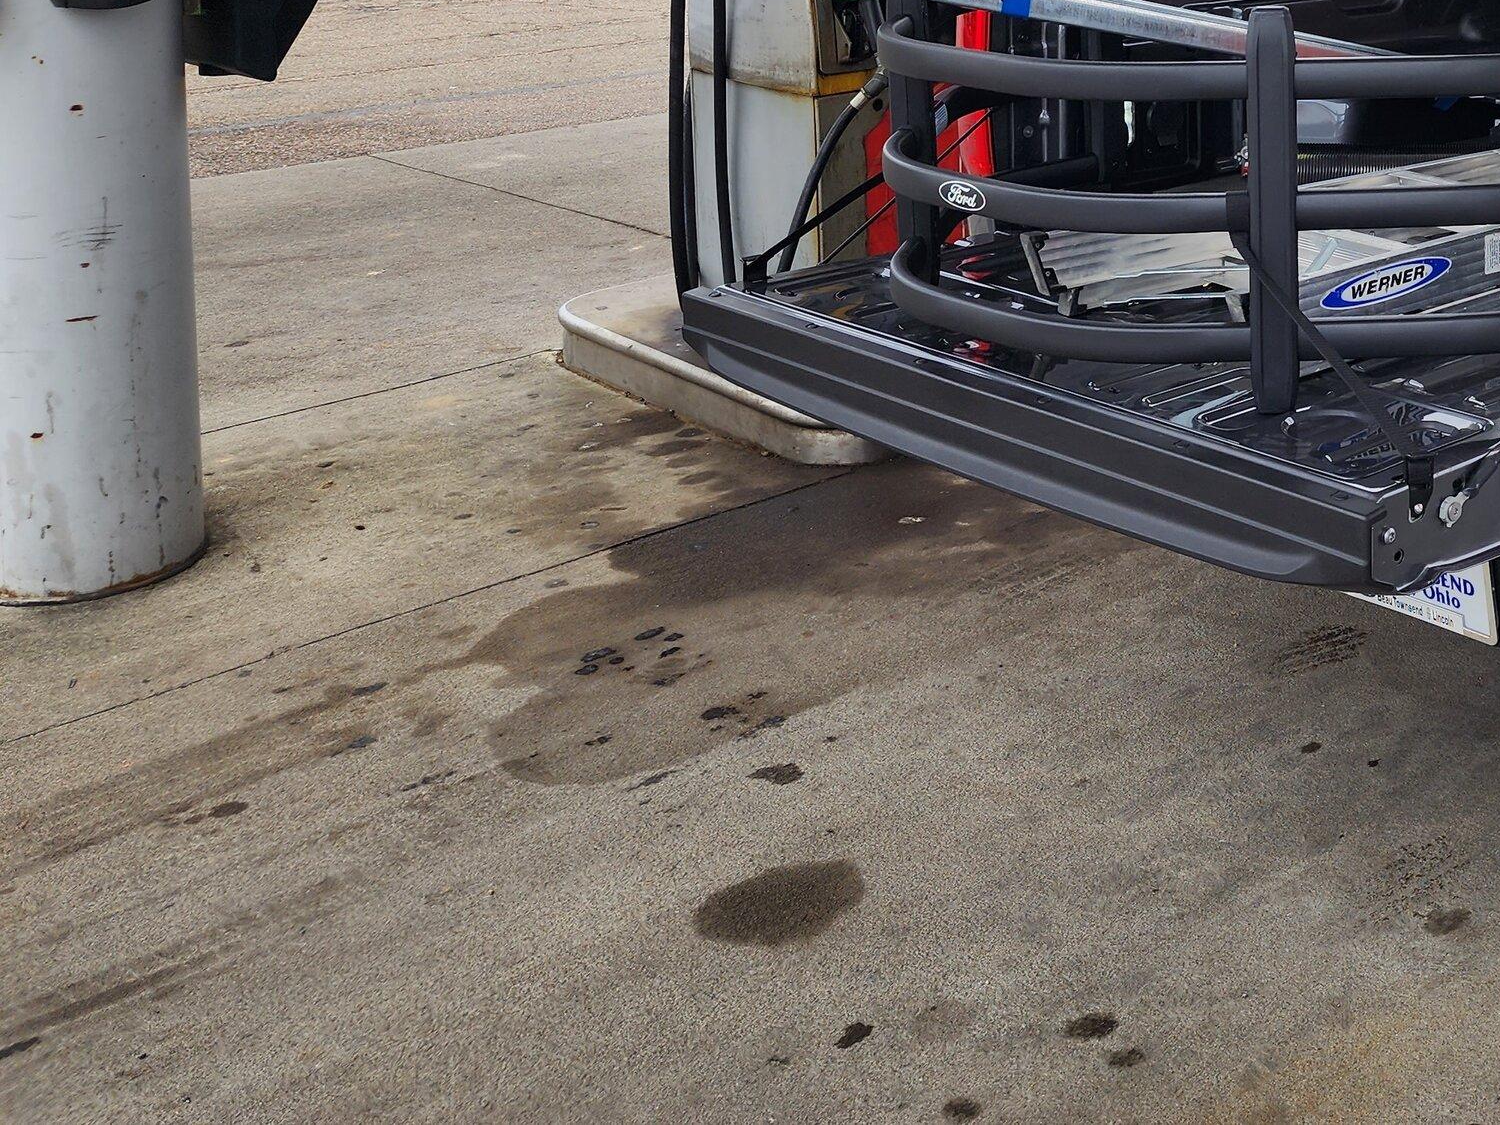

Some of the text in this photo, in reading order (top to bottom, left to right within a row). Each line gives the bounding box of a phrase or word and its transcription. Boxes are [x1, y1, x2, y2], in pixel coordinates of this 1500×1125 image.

[948, 184, 977, 208] Ford
[1351, 265, 1426, 300] WERNER
[1393, 595, 1424, 617] Townsend
